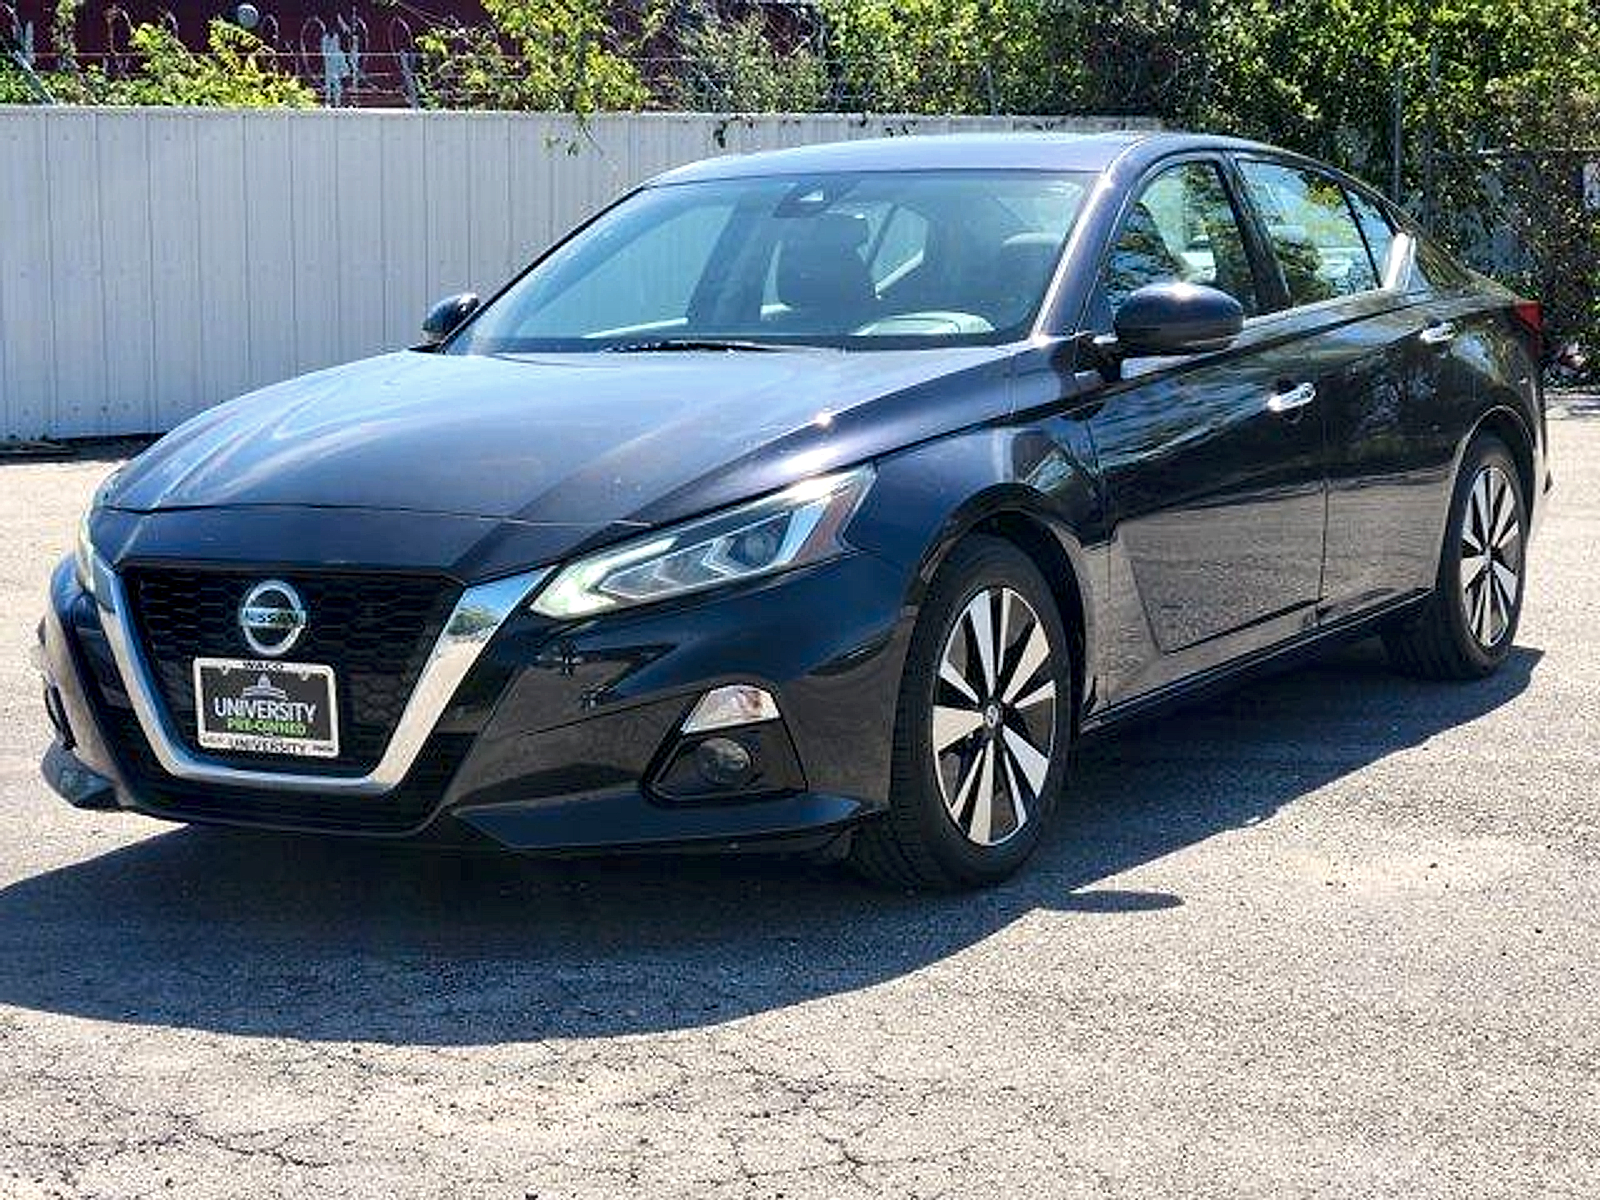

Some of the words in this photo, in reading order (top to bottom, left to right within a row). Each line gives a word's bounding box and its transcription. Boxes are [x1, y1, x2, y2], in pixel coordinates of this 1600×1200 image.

[243, 660, 284, 671] WACO
[214, 697, 317, 723] UNIVERSITY
[227, 718, 307, 736] PRE-OWNED
[233, 740, 307, 755] UNIVERSITY
